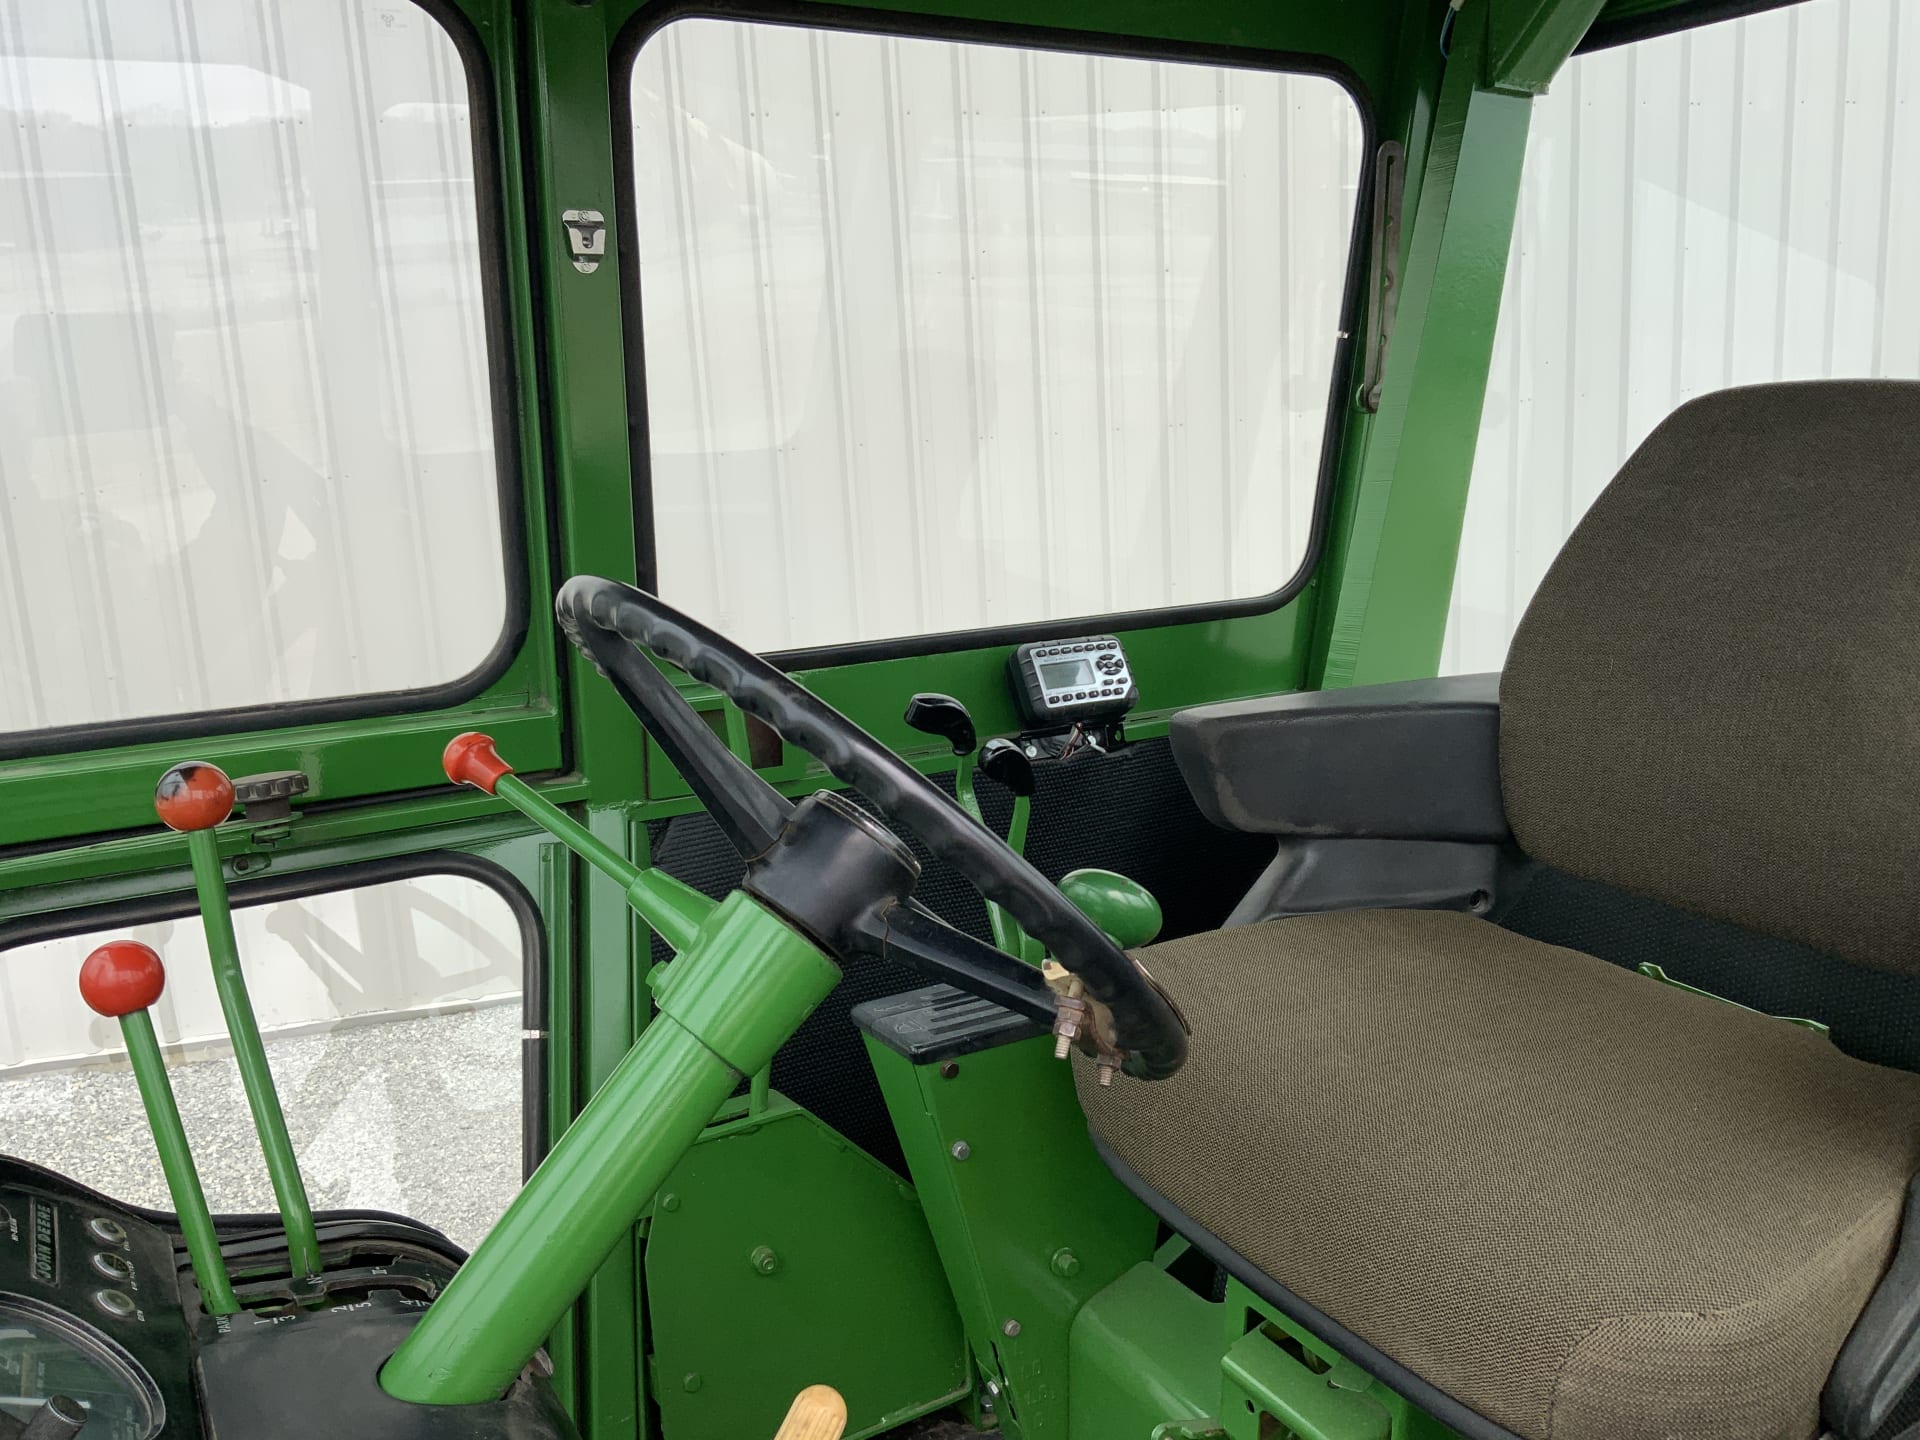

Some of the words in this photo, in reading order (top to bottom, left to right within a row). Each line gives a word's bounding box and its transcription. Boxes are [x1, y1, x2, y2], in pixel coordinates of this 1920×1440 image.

[37, 1203, 51, 1243] DEERE
[37, 1243, 51, 1279] JOHN
[331, 1304, 348, 1313] 2
[215, 1315, 232, 1334] PARK
